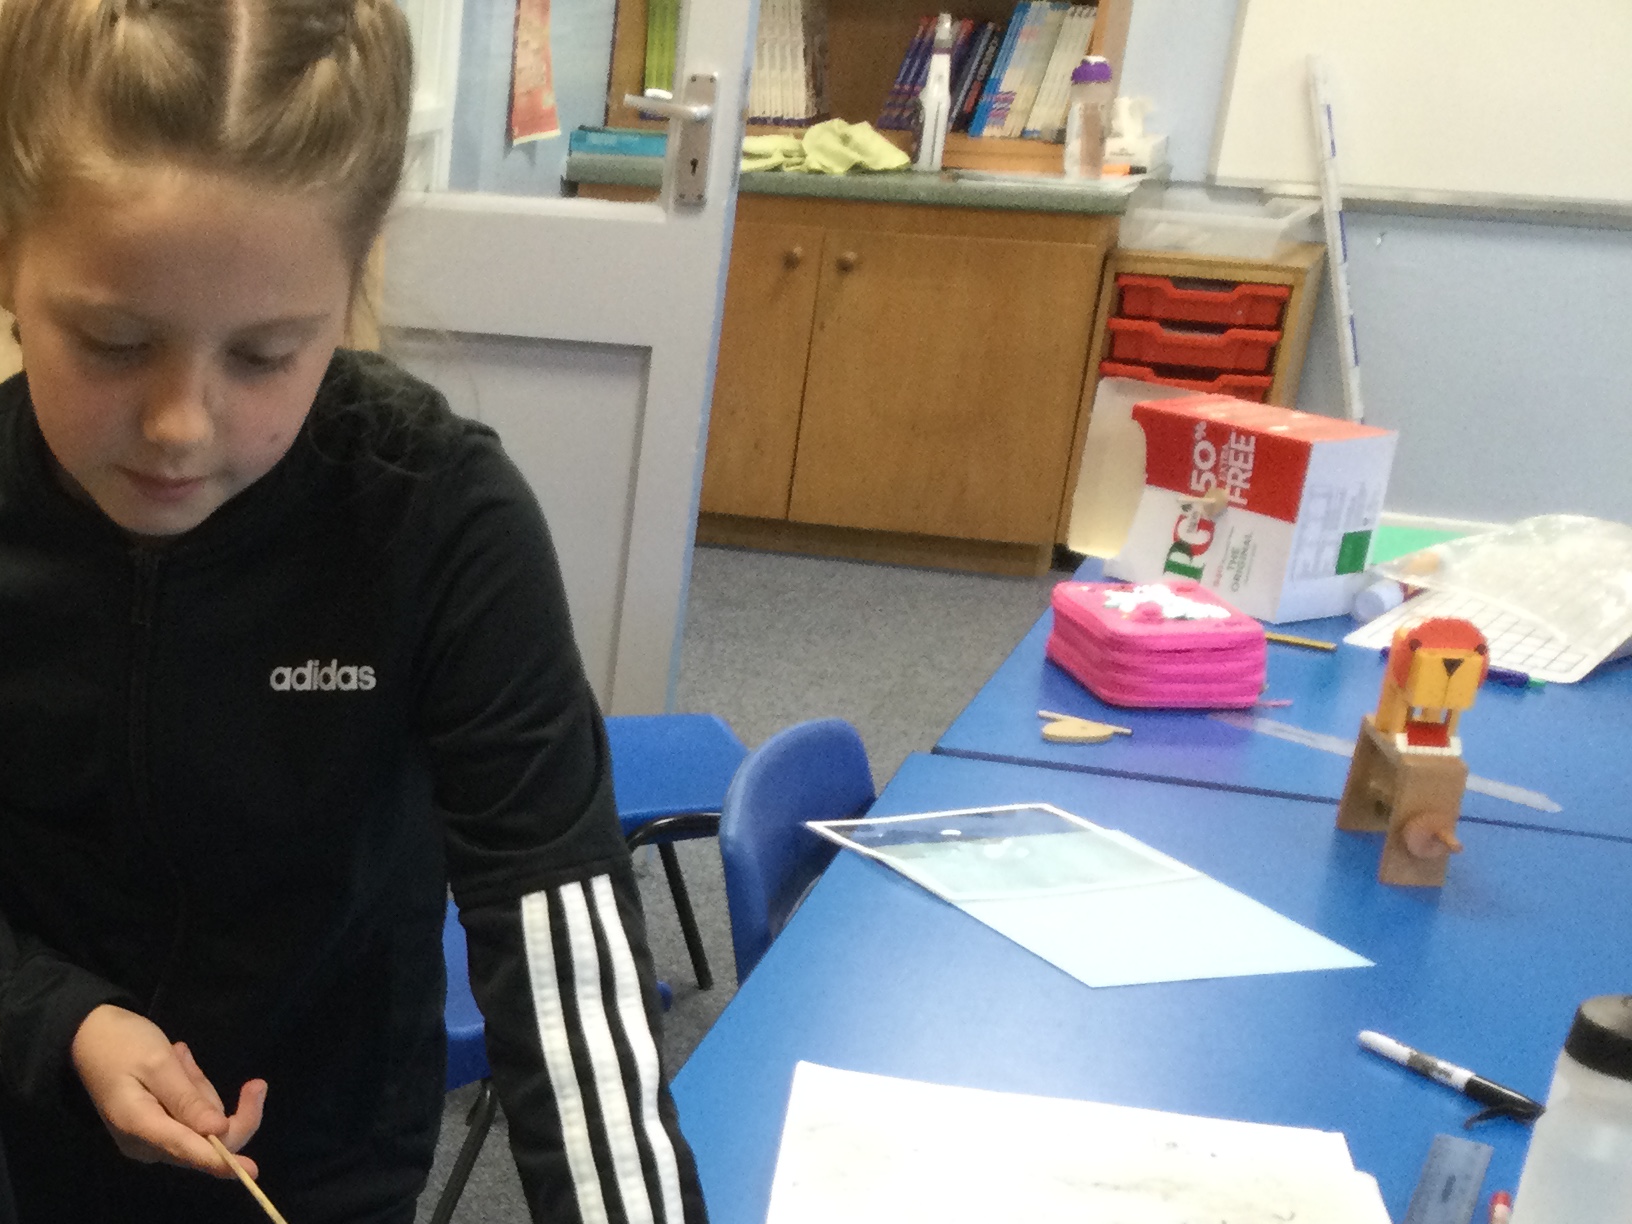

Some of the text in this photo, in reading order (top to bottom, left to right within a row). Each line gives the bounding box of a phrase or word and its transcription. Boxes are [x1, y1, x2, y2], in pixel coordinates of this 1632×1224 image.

[1227, 430, 1256, 506] FREE
[1162, 513, 1216, 583] PG
[269, 658, 377, 692] adidas
